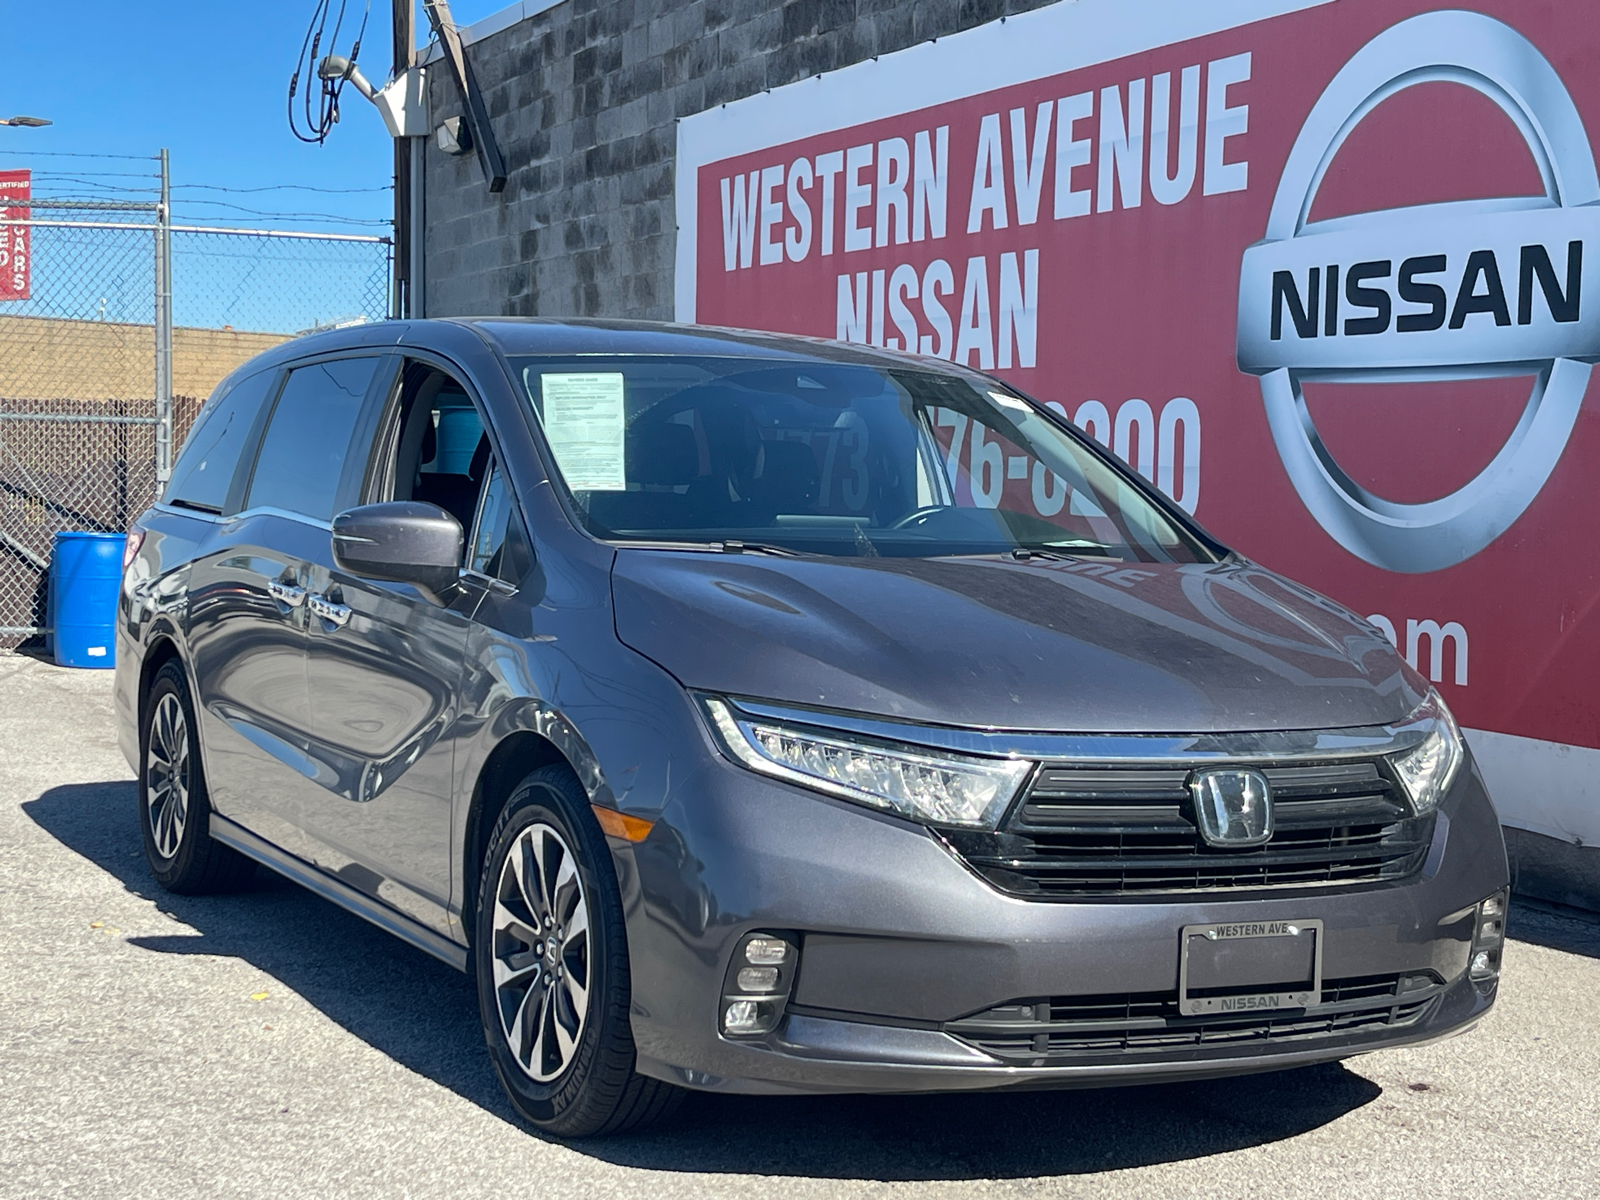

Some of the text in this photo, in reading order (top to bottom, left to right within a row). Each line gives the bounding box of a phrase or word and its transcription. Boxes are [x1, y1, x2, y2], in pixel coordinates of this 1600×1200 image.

[719, 50, 1253, 273] WESTERN AVENUE
[836, 248, 1040, 370] NISSAN
[1269, 240, 1584, 341] NISSAN
[1216, 923, 1266, 937] WESTERN
[1220, 995, 1280, 1011] NISSAN
